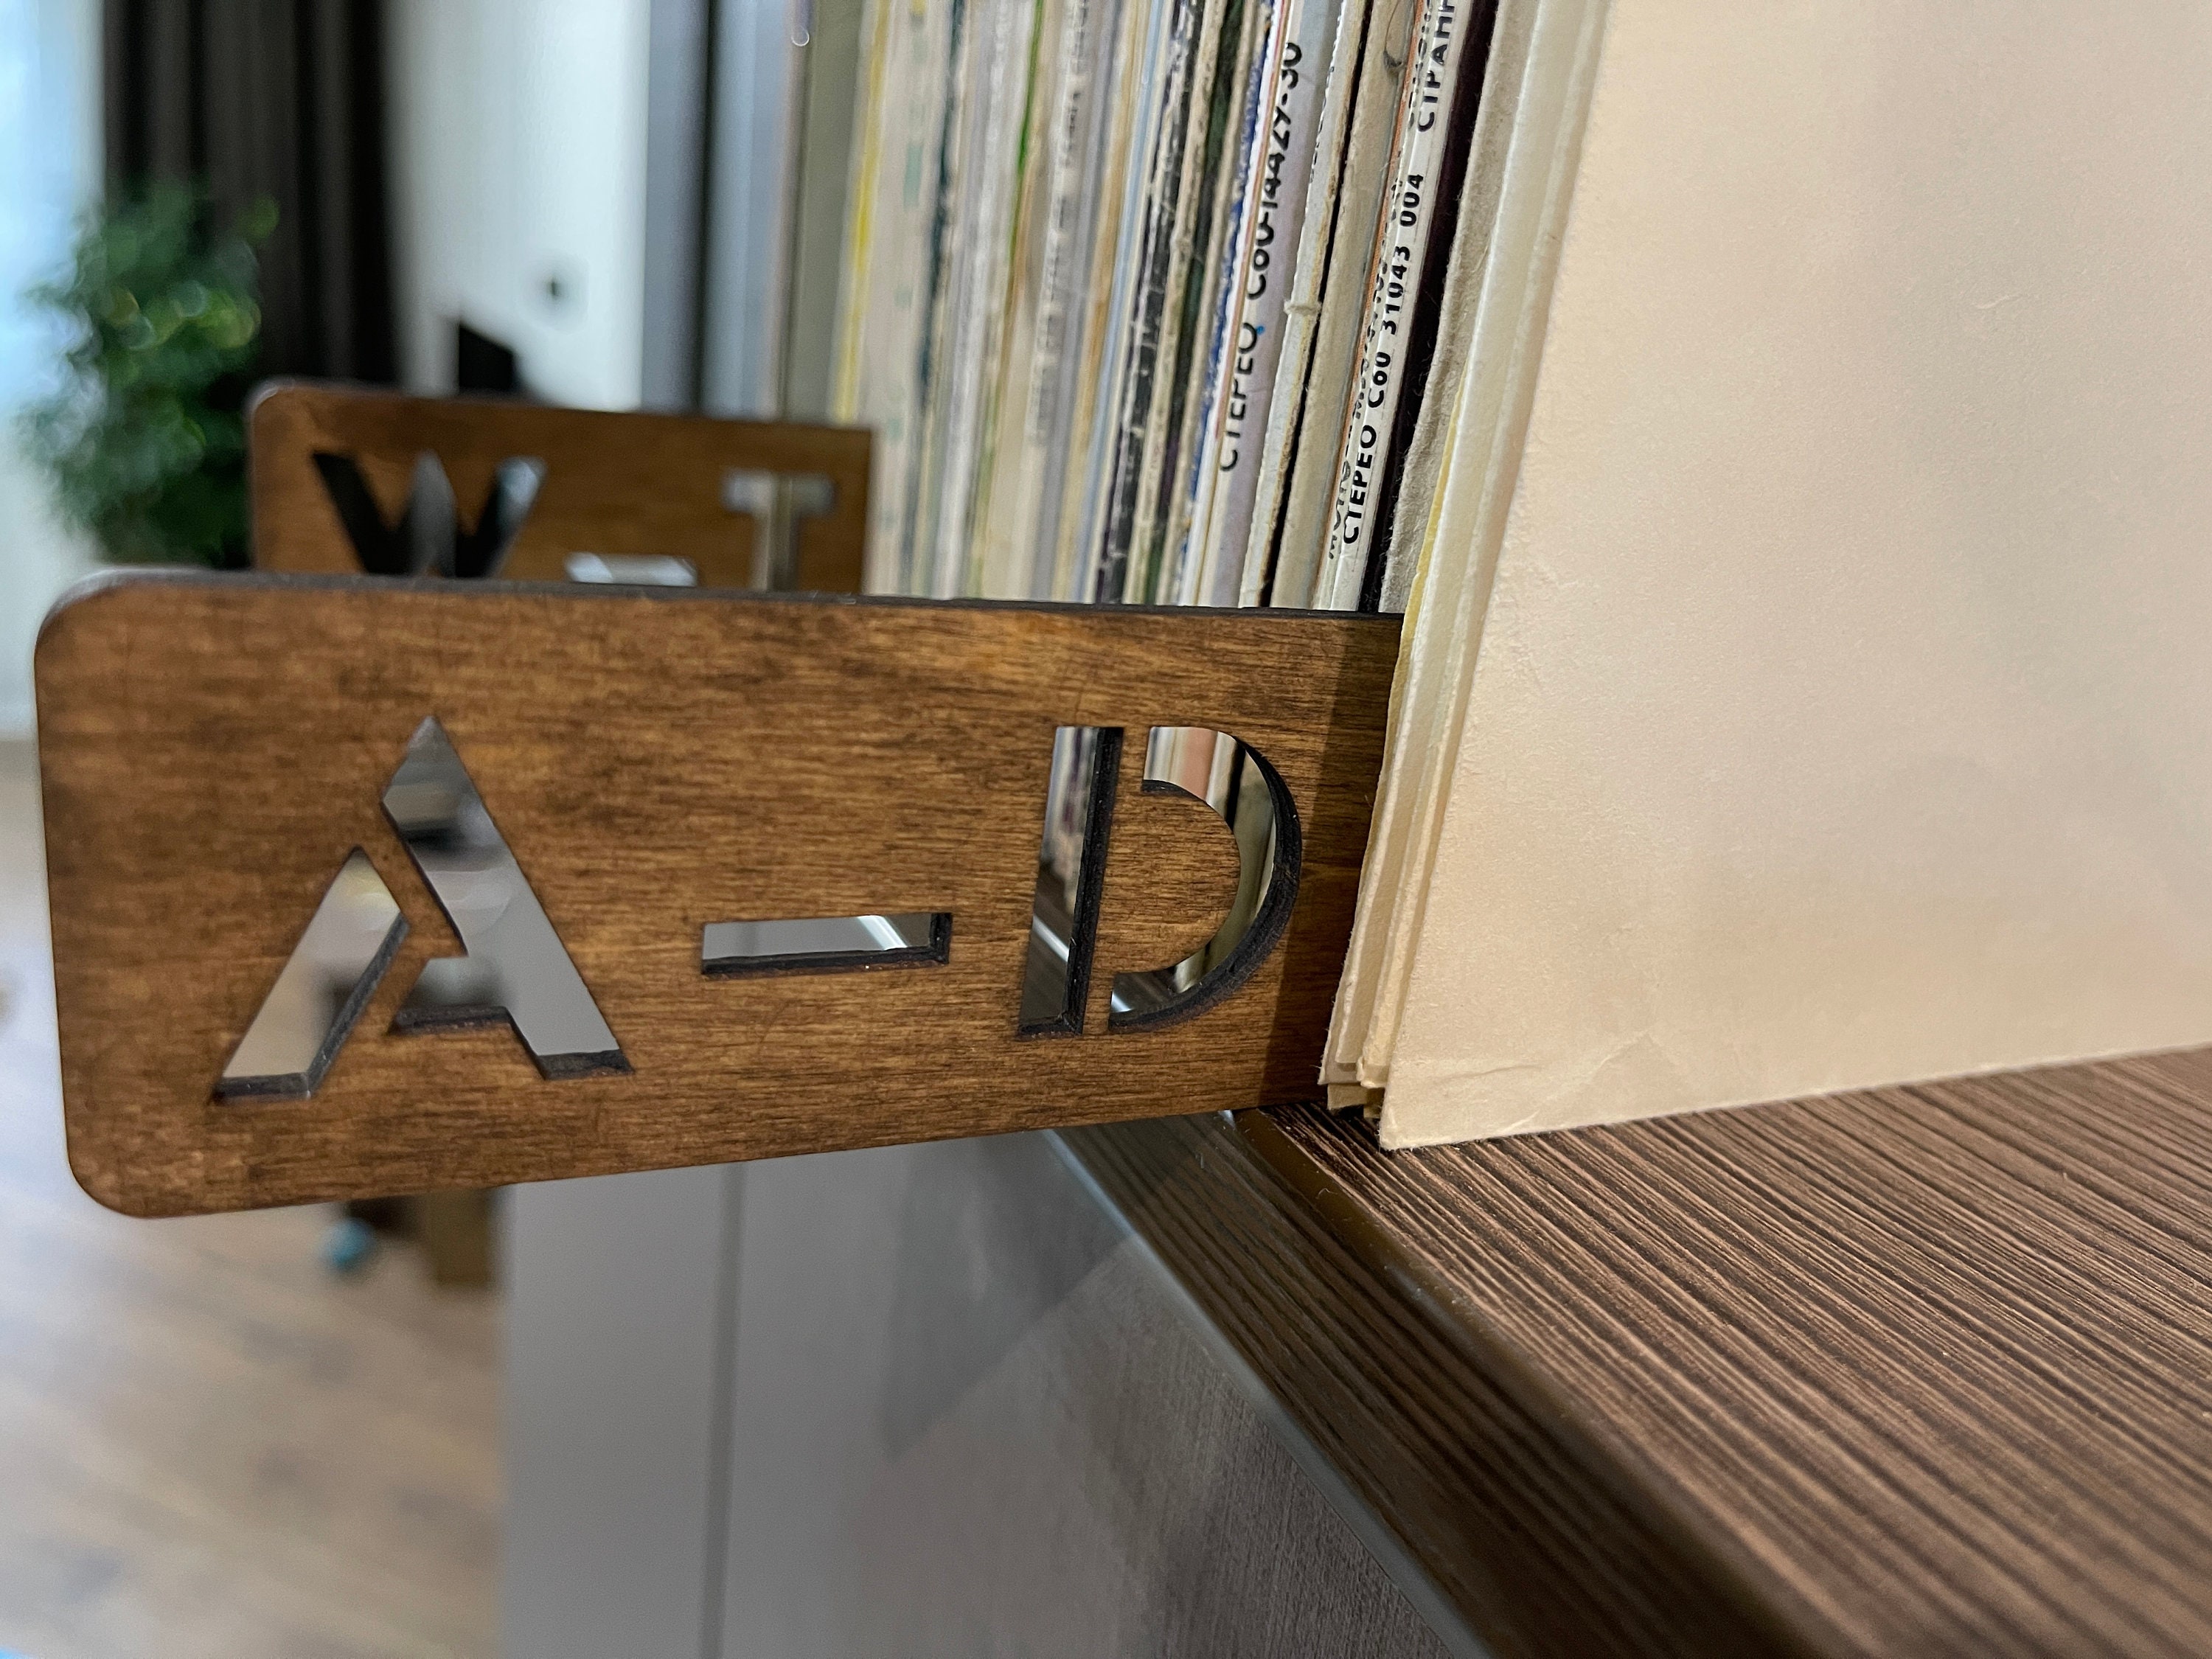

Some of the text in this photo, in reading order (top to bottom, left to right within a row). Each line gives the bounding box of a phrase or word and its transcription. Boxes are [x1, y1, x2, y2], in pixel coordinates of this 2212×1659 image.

[1219, 321, 1258, 472] СТЕРЕО
[1343, 424, 1377, 545] СТЕРЕО
[1366, 351, 1392, 409] С60
[1399, 173, 1424, 227] 004
